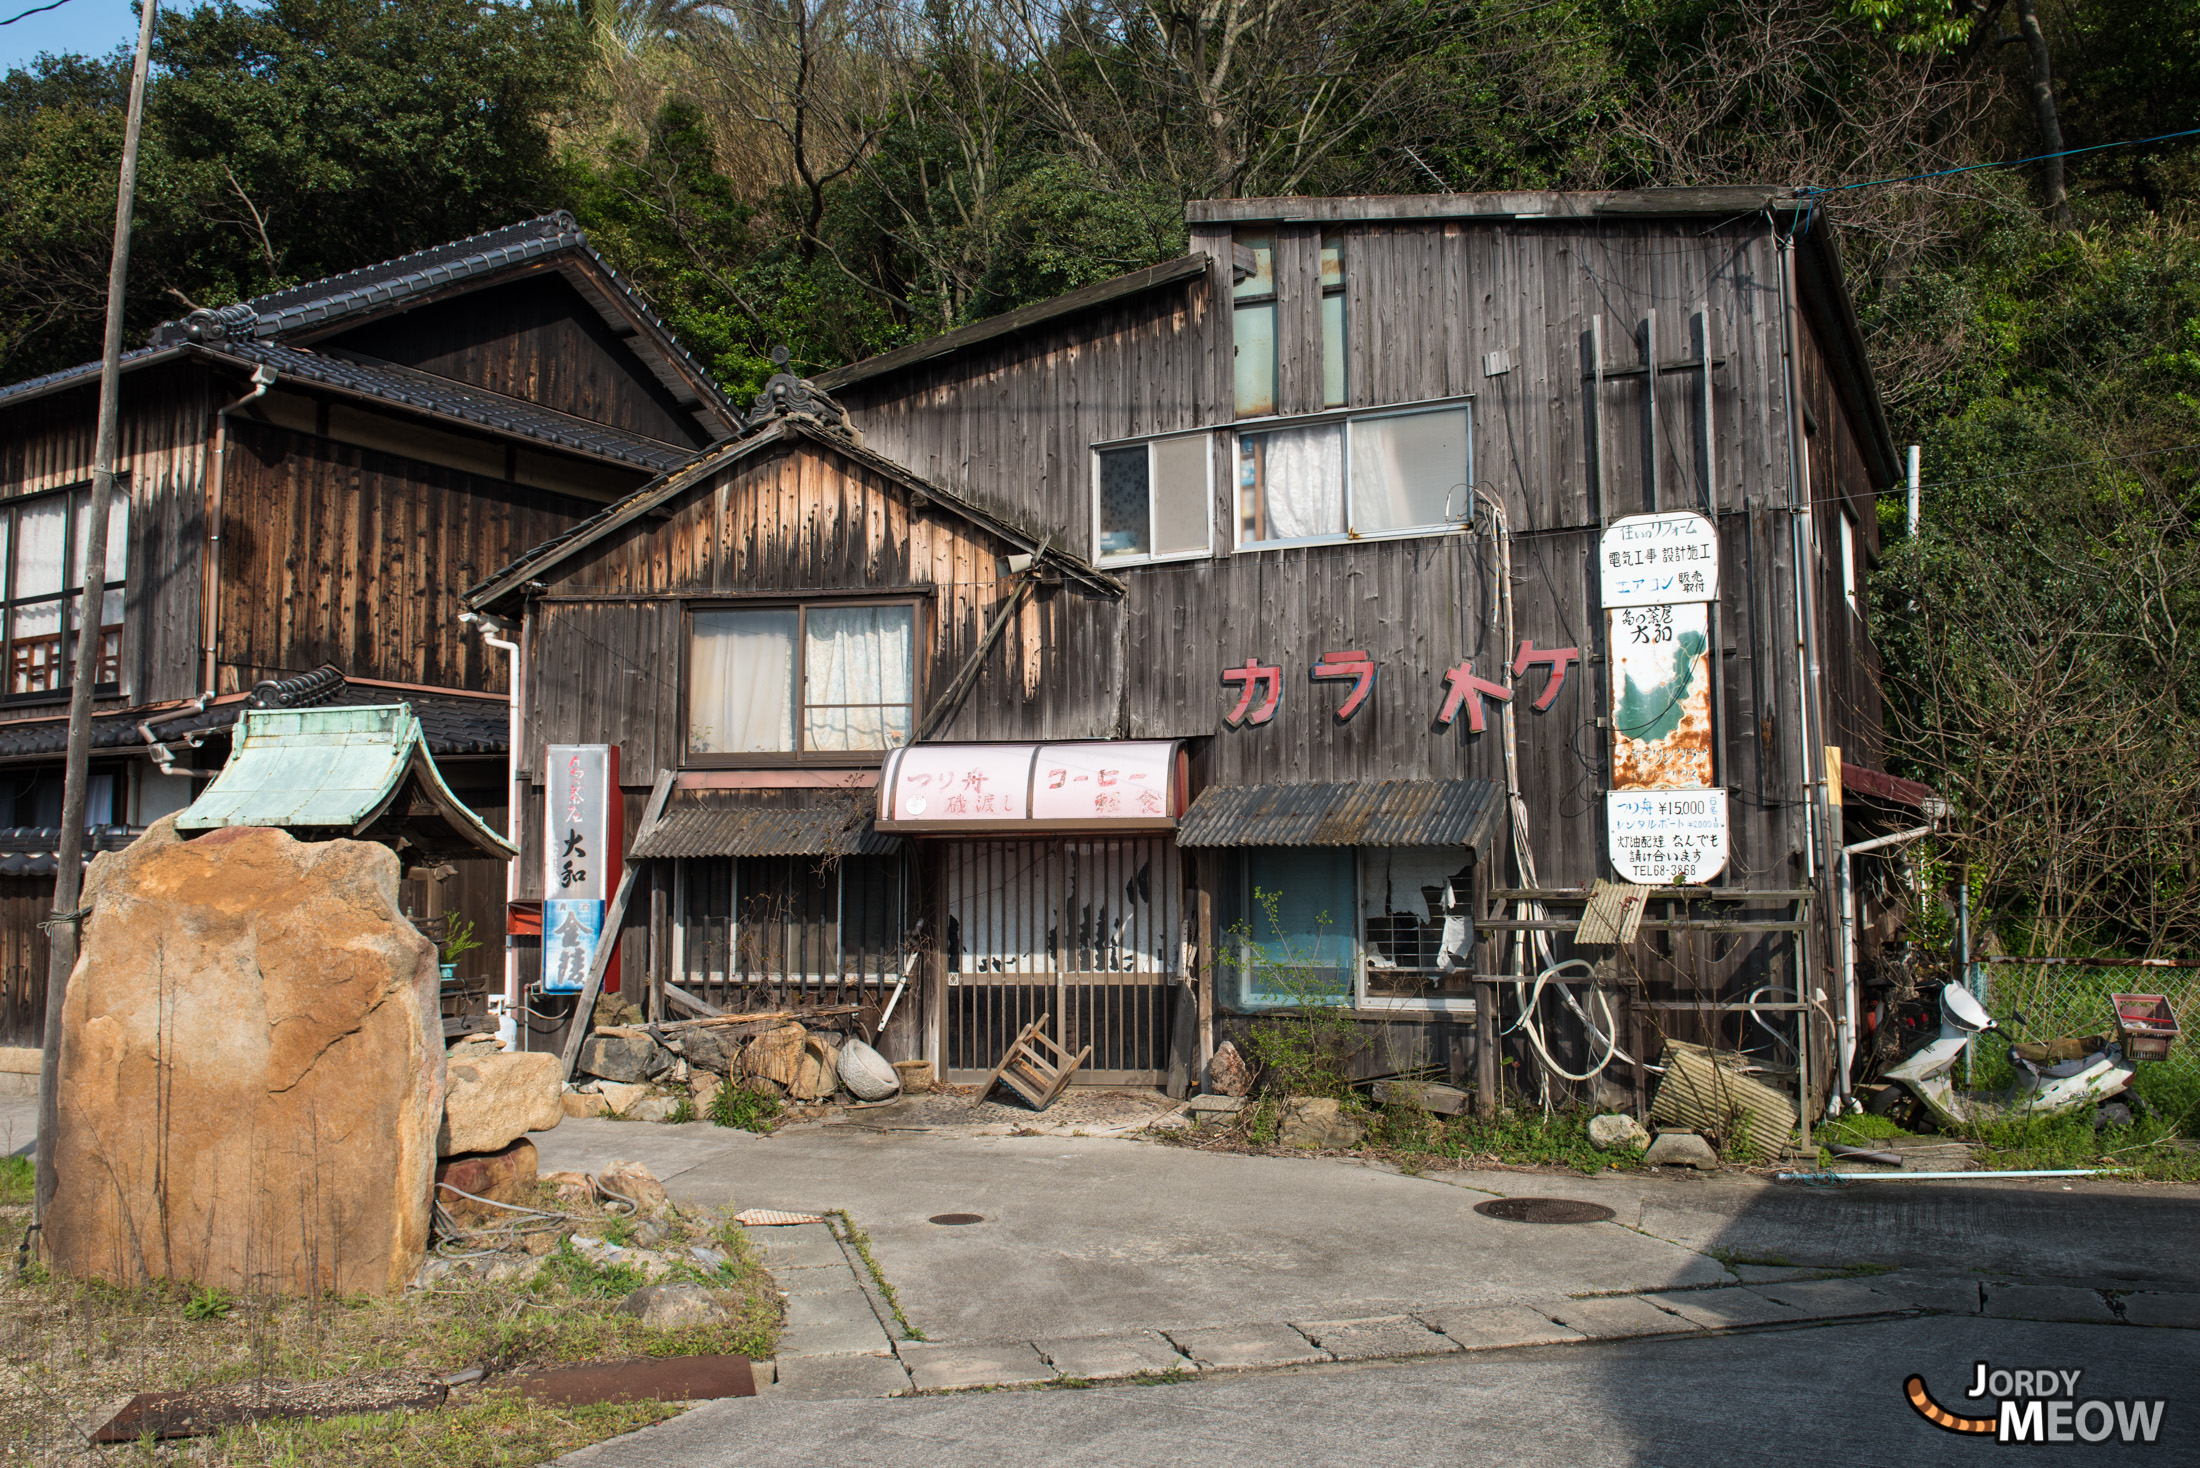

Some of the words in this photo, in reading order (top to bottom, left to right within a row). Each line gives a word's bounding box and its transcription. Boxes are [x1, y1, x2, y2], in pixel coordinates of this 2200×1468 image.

[1620, 520, 1697, 540] 住いのリフォーム
[1608, 548, 1657, 567] 電気工事
[1662, 543, 1711, 563] 設計施工
[1616, 576, 1674, 593] エアコン
[1678, 570, 1704, 584] 販売
[1682, 582, 1705, 593] 取付
[1622, 605, 1673, 626] 島の茶屋
[1630, 624, 1673, 644] 大和
[1048, 768, 1148, 789] コーヒー
[1616, 798, 1653, 815] つり舟
[1617, 818, 1684, 829] レンタルボート
[1617, 835, 1665, 848] 灯油配達
[1672, 834, 1719, 847] なんでも
[561, 828, 586, 888] 大和
[1629, 849, 1702, 863] 請け合います
